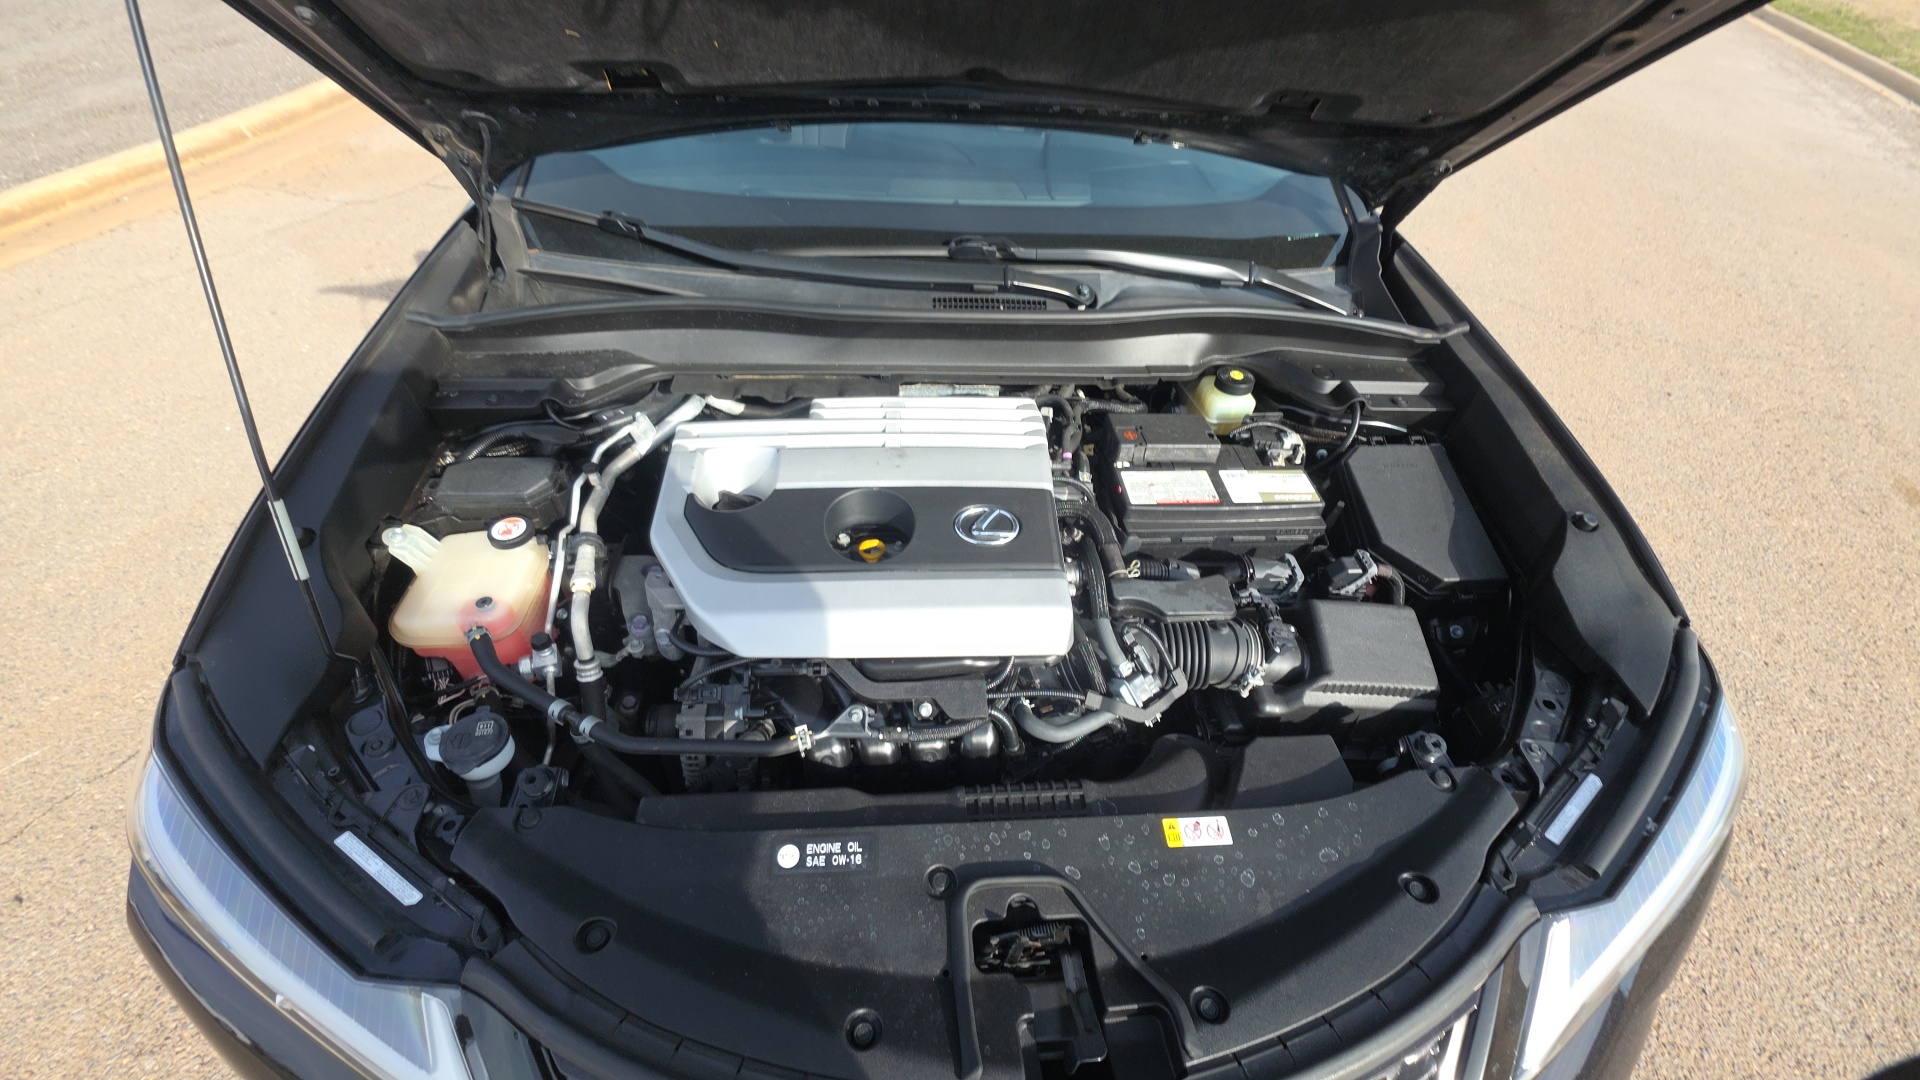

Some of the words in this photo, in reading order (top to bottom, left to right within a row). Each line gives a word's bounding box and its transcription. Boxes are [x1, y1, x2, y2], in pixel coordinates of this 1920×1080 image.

[806, 842, 841, 854] ENGINE
[847, 841, 862, 853] OIL
[806, 855, 826, 867] SAE
